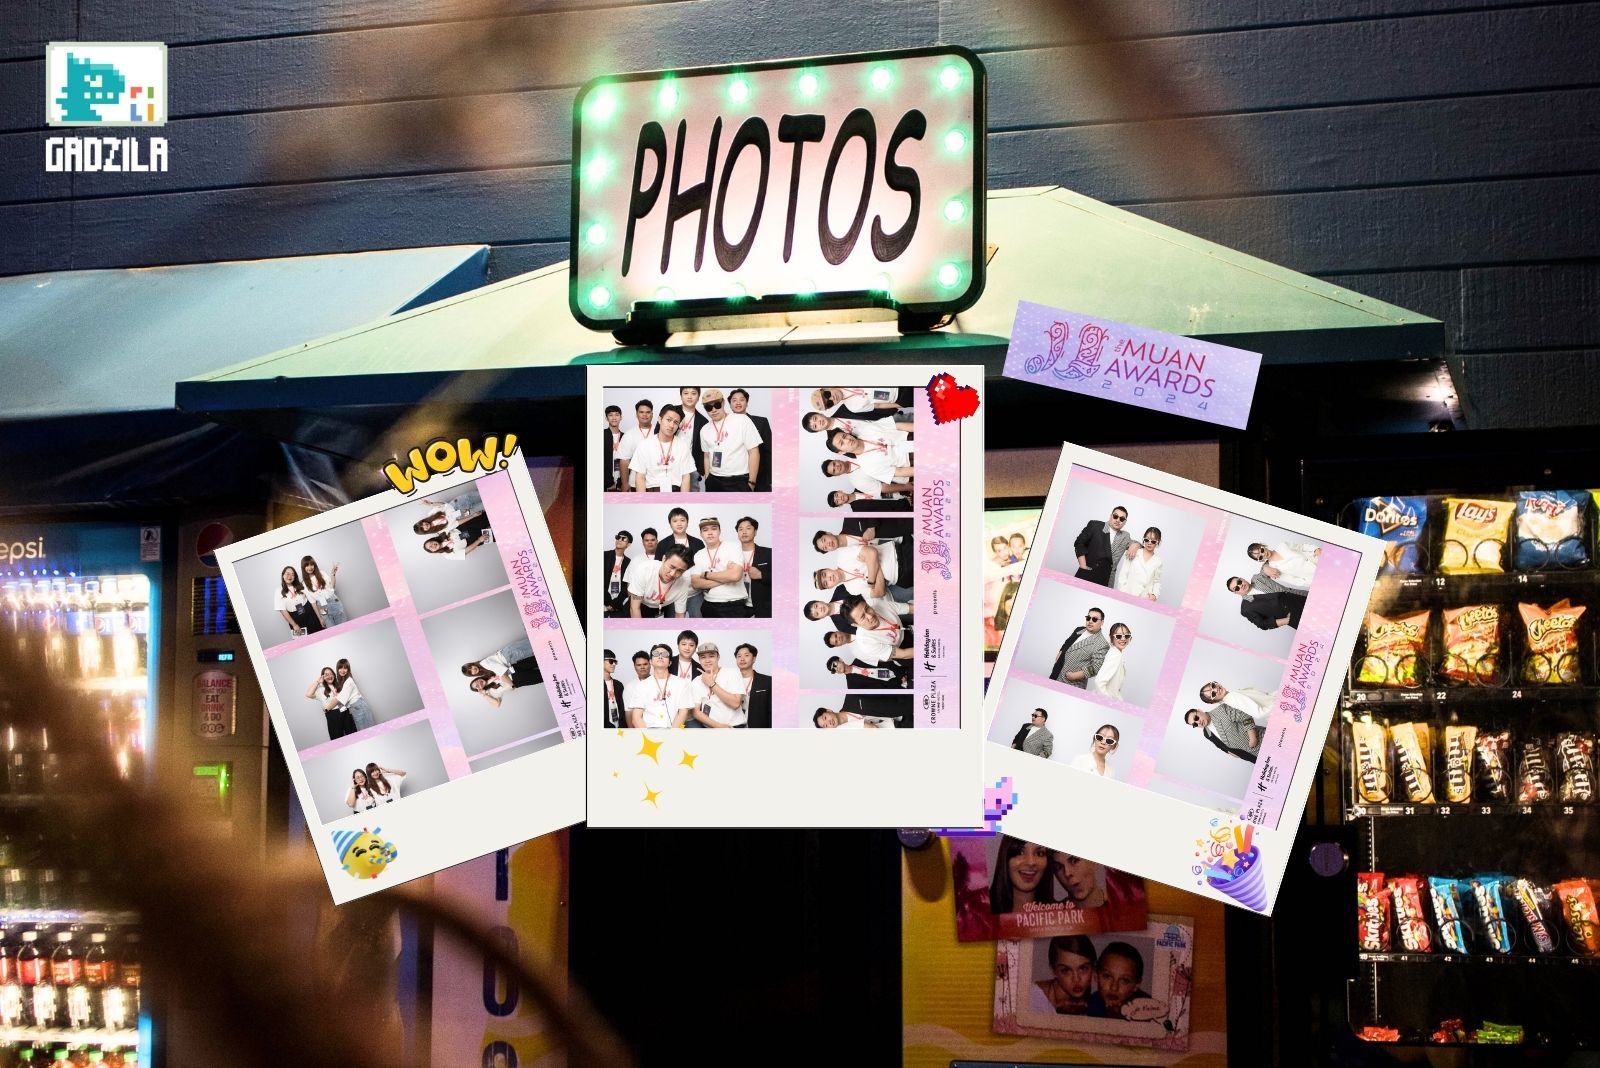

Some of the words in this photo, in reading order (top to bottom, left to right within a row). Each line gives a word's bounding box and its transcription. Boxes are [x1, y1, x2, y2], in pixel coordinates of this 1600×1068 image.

[621, 107, 927, 277] PHOTOS
[1364, 504, 1418, 526] Doritos
[1435, 577, 1445, 586] 12
[1518, 575, 1528, 583] 14
[1529, 616, 1577, 641] Cheetos
[1356, 693, 1367, 701] 20
[1436, 692, 1446, 700] 22
[1512, 690, 1522, 698] 24
[205, 695, 220, 703] EAT
[1023, 901, 1064, 912] Welcome
[1065, 900, 1076, 909] to
[1016, 911, 1055, 927] PACIFIC
[1057, 909, 1085, 925] PARK
